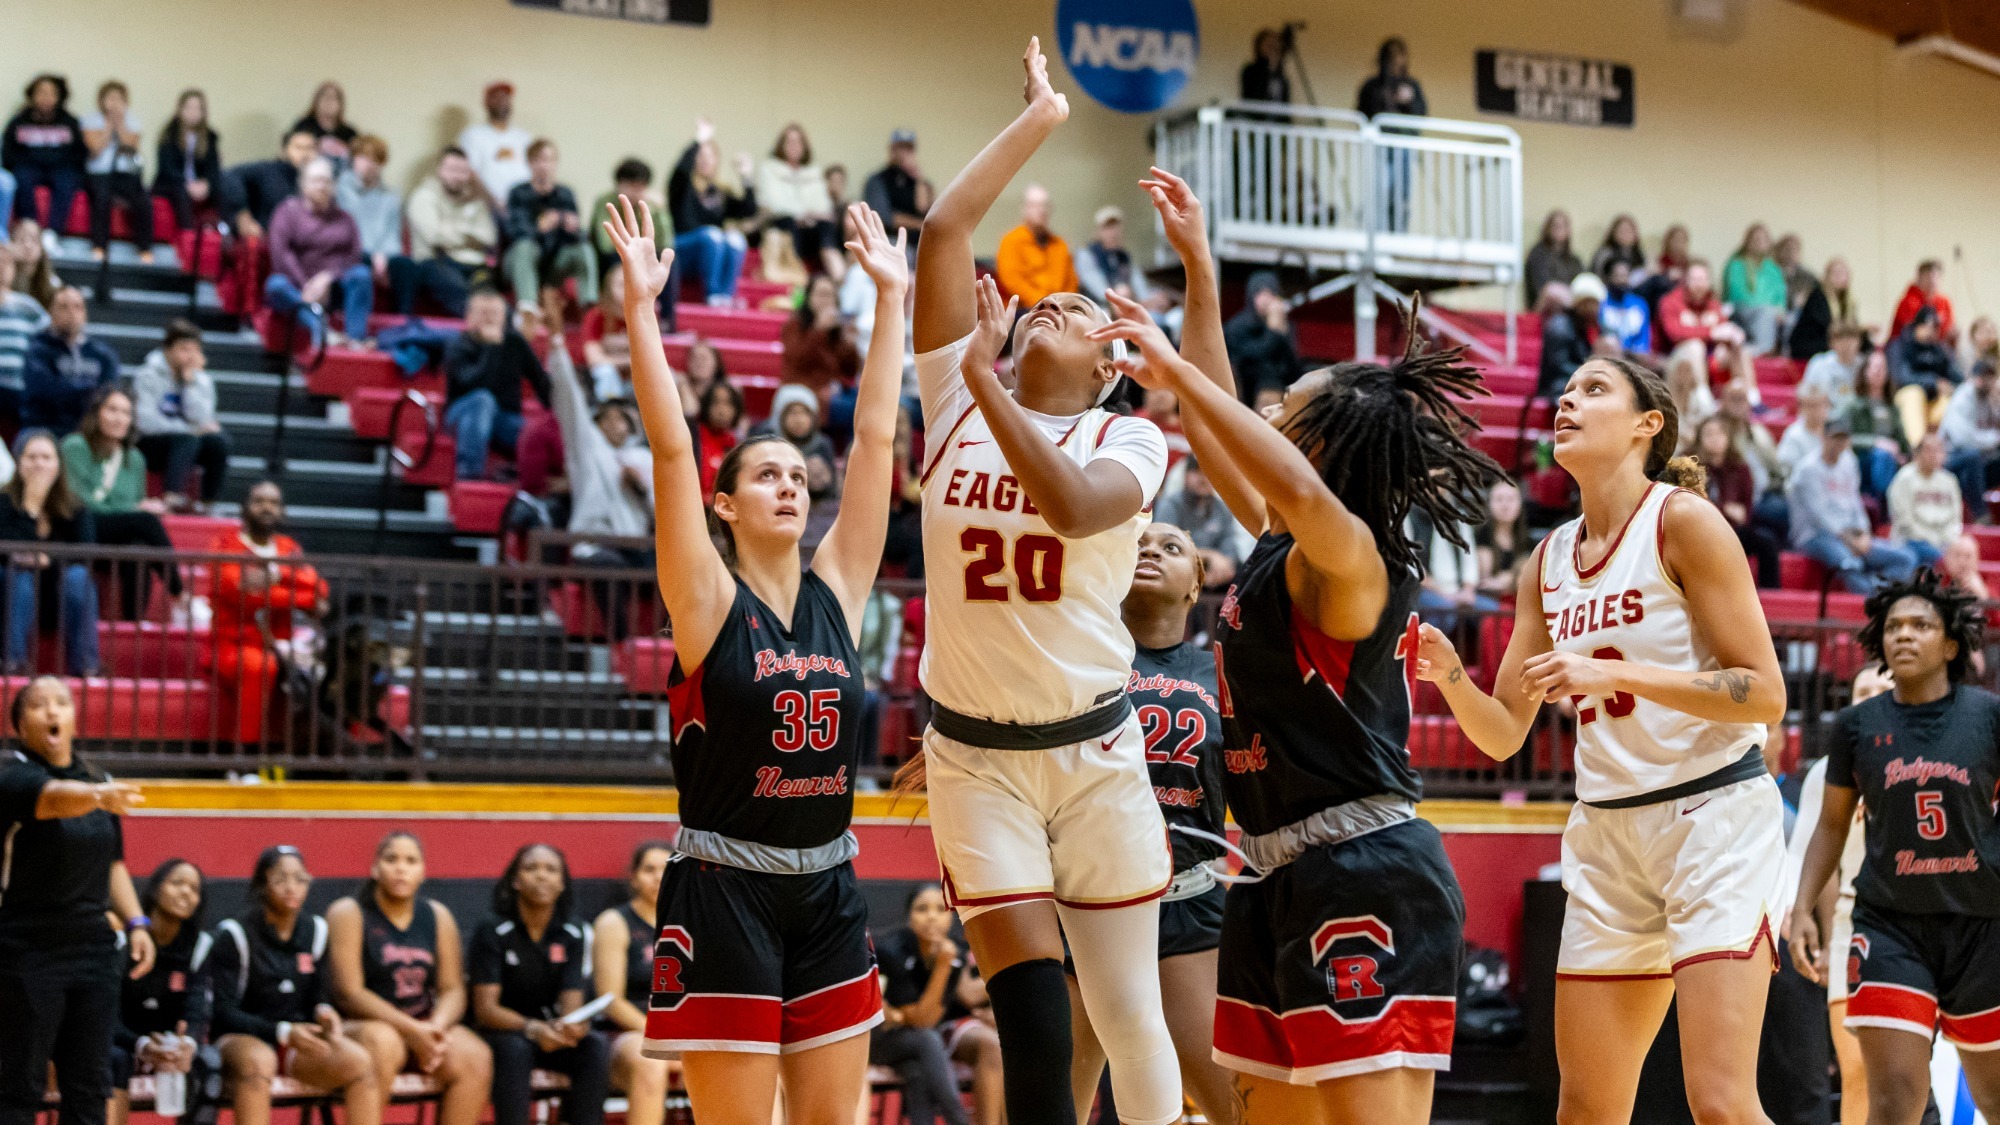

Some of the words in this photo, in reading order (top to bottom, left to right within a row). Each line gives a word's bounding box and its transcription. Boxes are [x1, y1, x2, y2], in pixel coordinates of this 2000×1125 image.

[1070, 22, 1195, 76] NCAA
[1495, 54, 1621, 99] GENERAL
[1516, 90, 1602, 125] SEATING
[943, 468, 1041, 515] EAGL
[959, 525, 1067, 605] 20
[754, 648, 851, 682] Rutgers
[1570, 645, 1637, 727] 3
[1126, 670, 1220, 713] Rutgers
[772, 688, 841, 752] 35
[1137, 704, 1207, 768] 22
[753, 765, 848, 798] Newark
[1884, 755, 1971, 789] Rutgers
[1915, 790, 1947, 840] 5
[1895, 848, 1979, 876] Newark
[652, 955, 685, 994] R
[1328, 954, 1385, 1003] R
